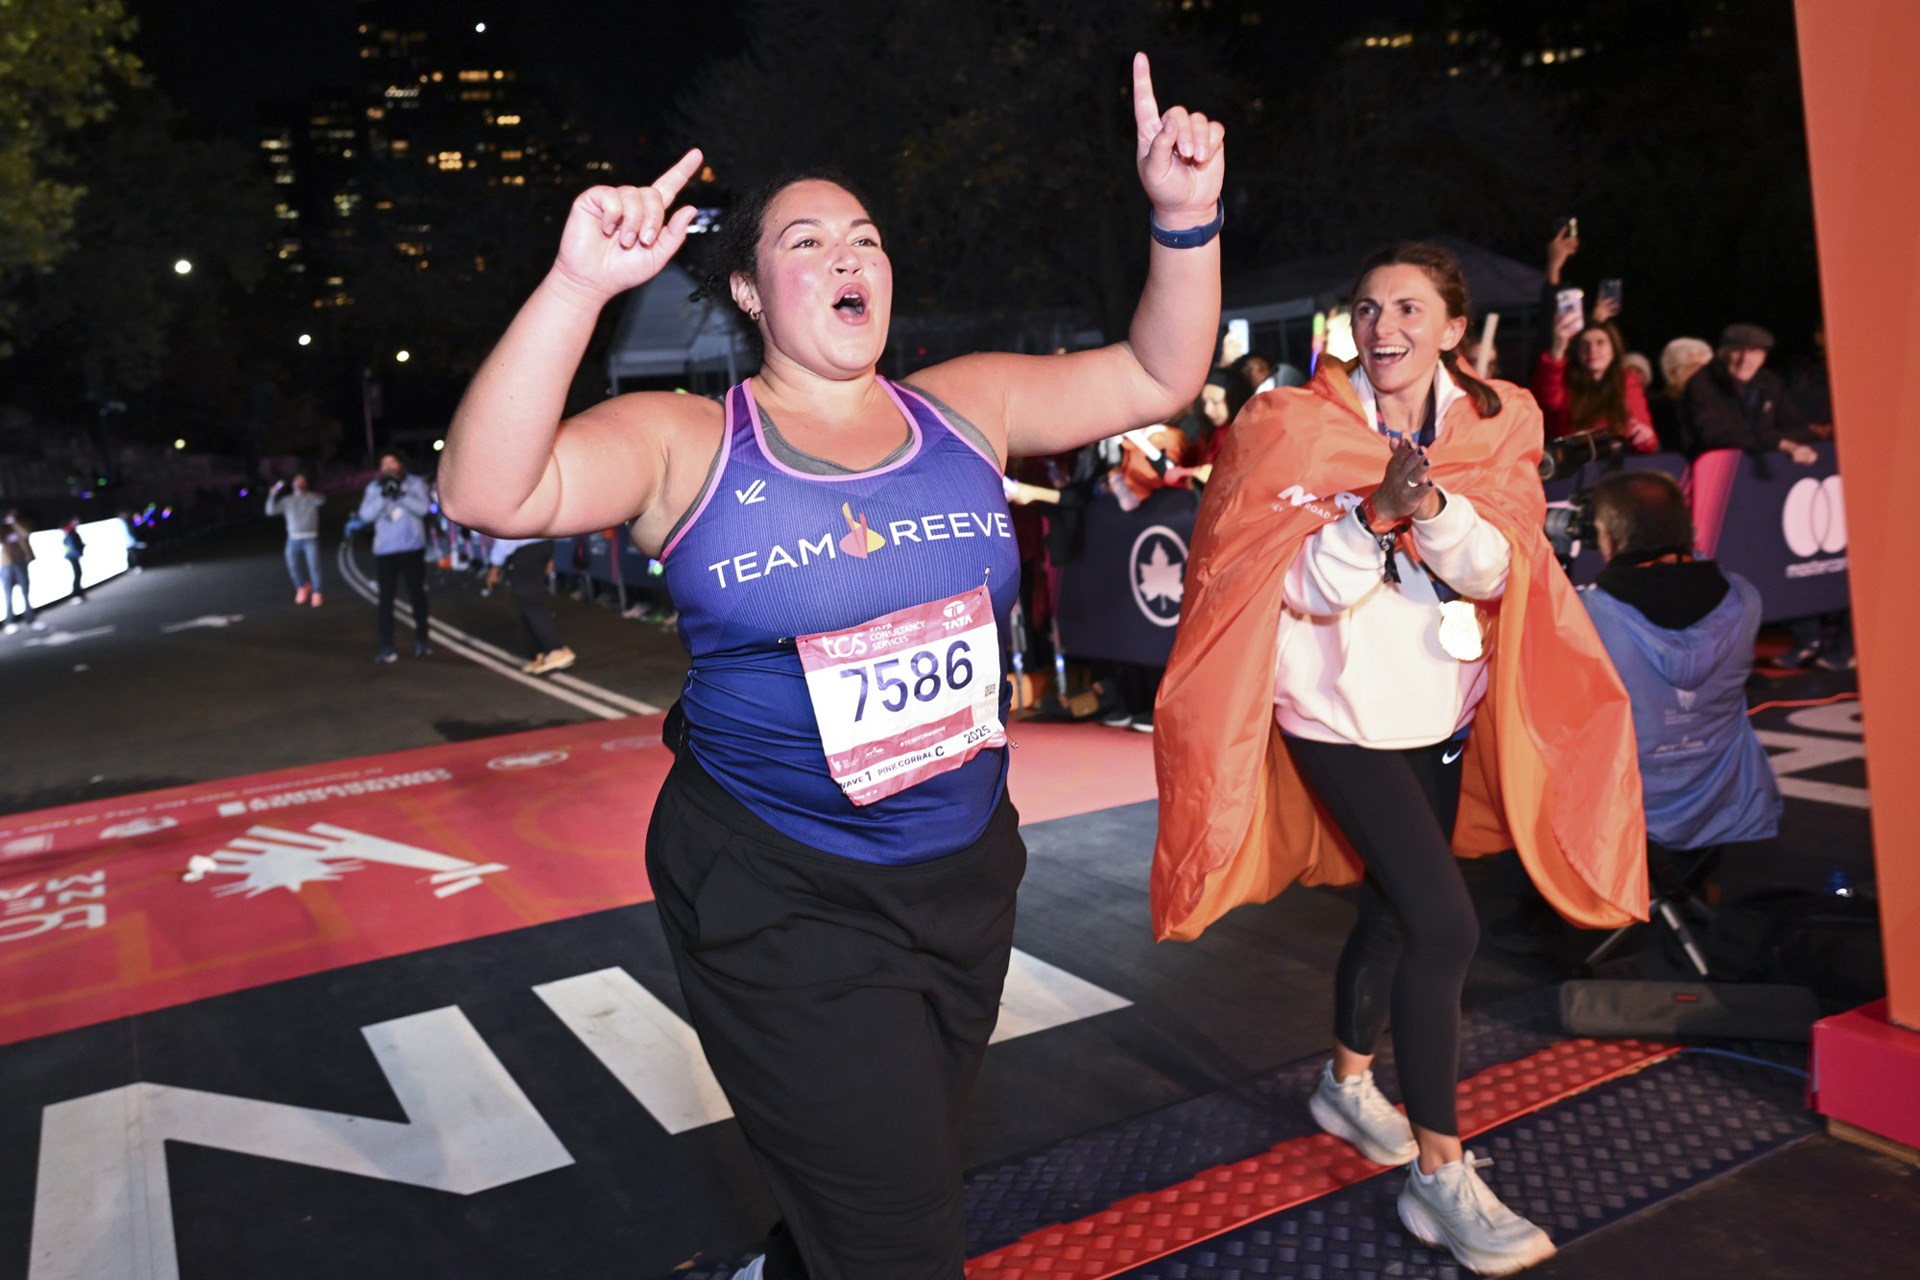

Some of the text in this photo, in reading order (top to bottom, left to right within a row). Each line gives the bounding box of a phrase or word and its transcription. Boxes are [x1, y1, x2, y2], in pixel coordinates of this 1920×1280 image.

[1304, 502, 1332, 520] ROAD
[708, 512, 1012, 589] TEAM REEVE
[942, 614, 974, 631] TATA
[871, 635, 910, 651] SERVICES
[839, 639, 974, 724] 7586
[864, 770, 873, 782] 1
[877, 763, 898, 776] PINK
[897, 751, 933, 768] CORRAL
[935, 745, 945, 757] C
[963, 725, 991, 744] 2025
